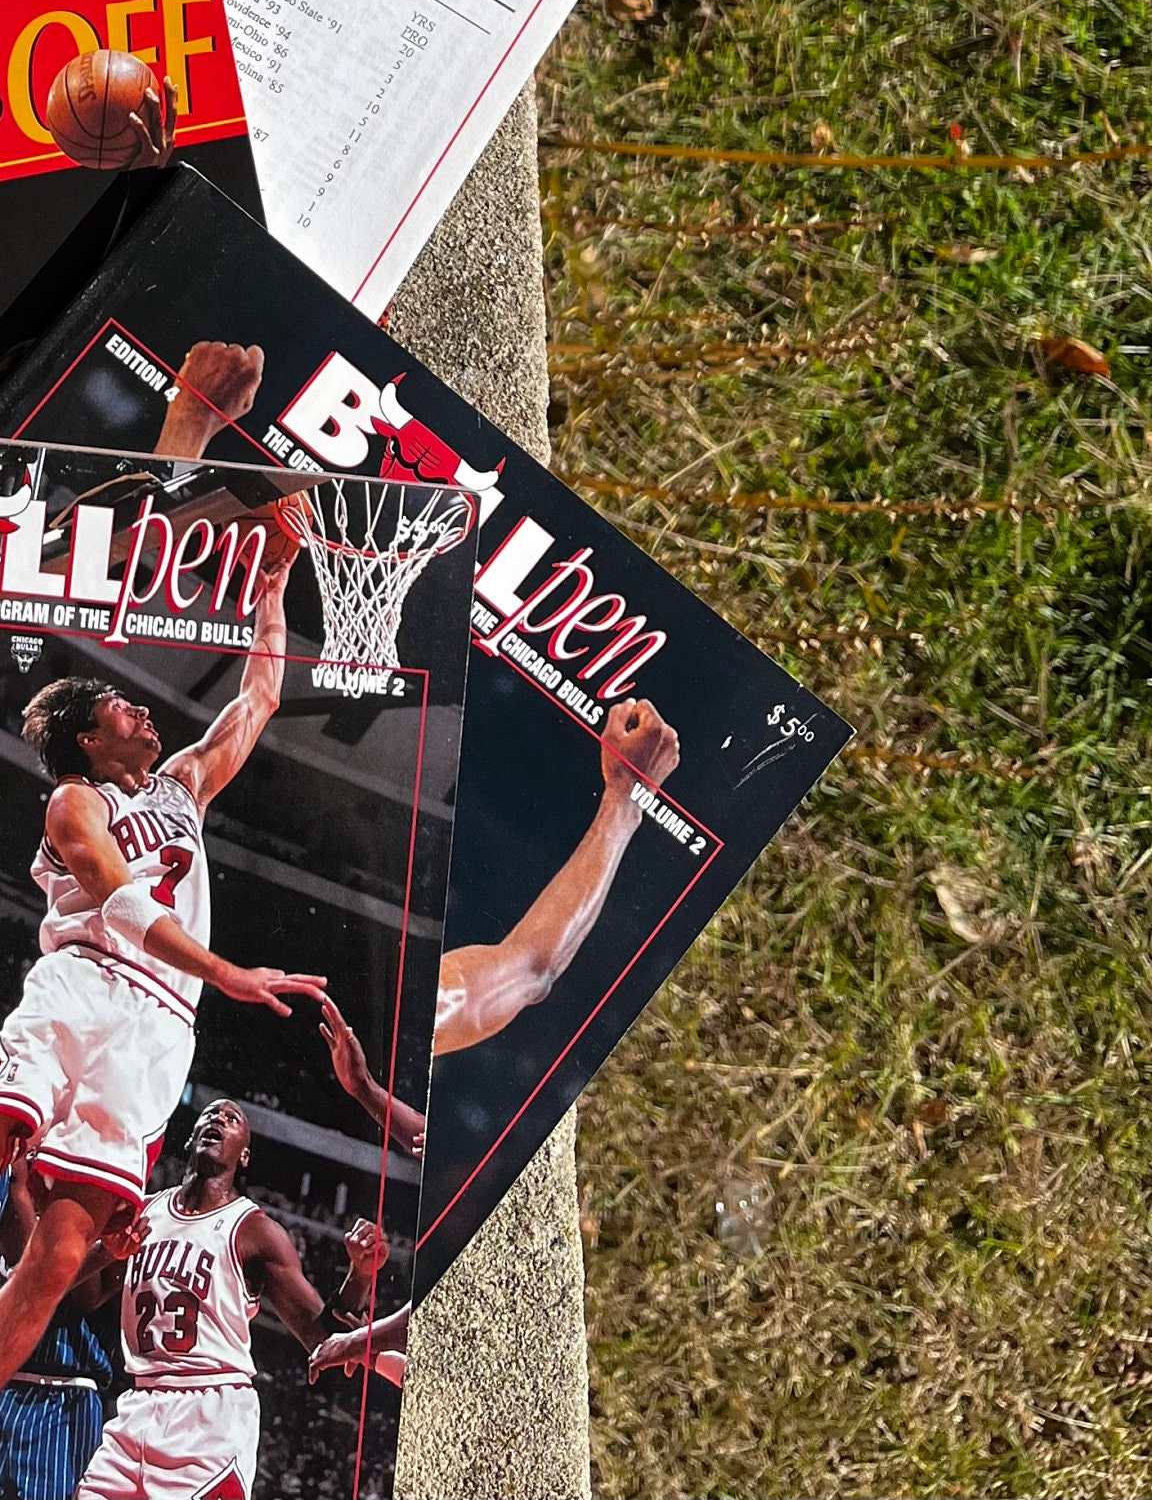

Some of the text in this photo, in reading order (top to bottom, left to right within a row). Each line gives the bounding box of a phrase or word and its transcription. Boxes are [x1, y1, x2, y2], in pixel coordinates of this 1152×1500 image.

[297, 1, 323, 22] State
[411, 11, 436, 32] YRS
[400, 25, 428, 49] PRO
[105, 334, 181, 402] EDITION 4
[261, 424, 290, 458] THE
[11, 635, 44, 646] CHICAGO
[52, 607, 77, 628] OF
[78, 608, 110, 632] THE
[125, 612, 200, 641] CHICAGO
[201, 623, 256, 647] BULLS
[15, 643, 40, 652] BULLS
[470, 602, 605, 727] THE CHICAGO BULLS
[311, 668, 408, 698] VOLUME 2
[628, 781, 708, 856] VOLUME 2
[150, 844, 194, 910] 7
[130, 1239, 216, 1302] BULLS
[134, 1291, 202, 1355] 23
